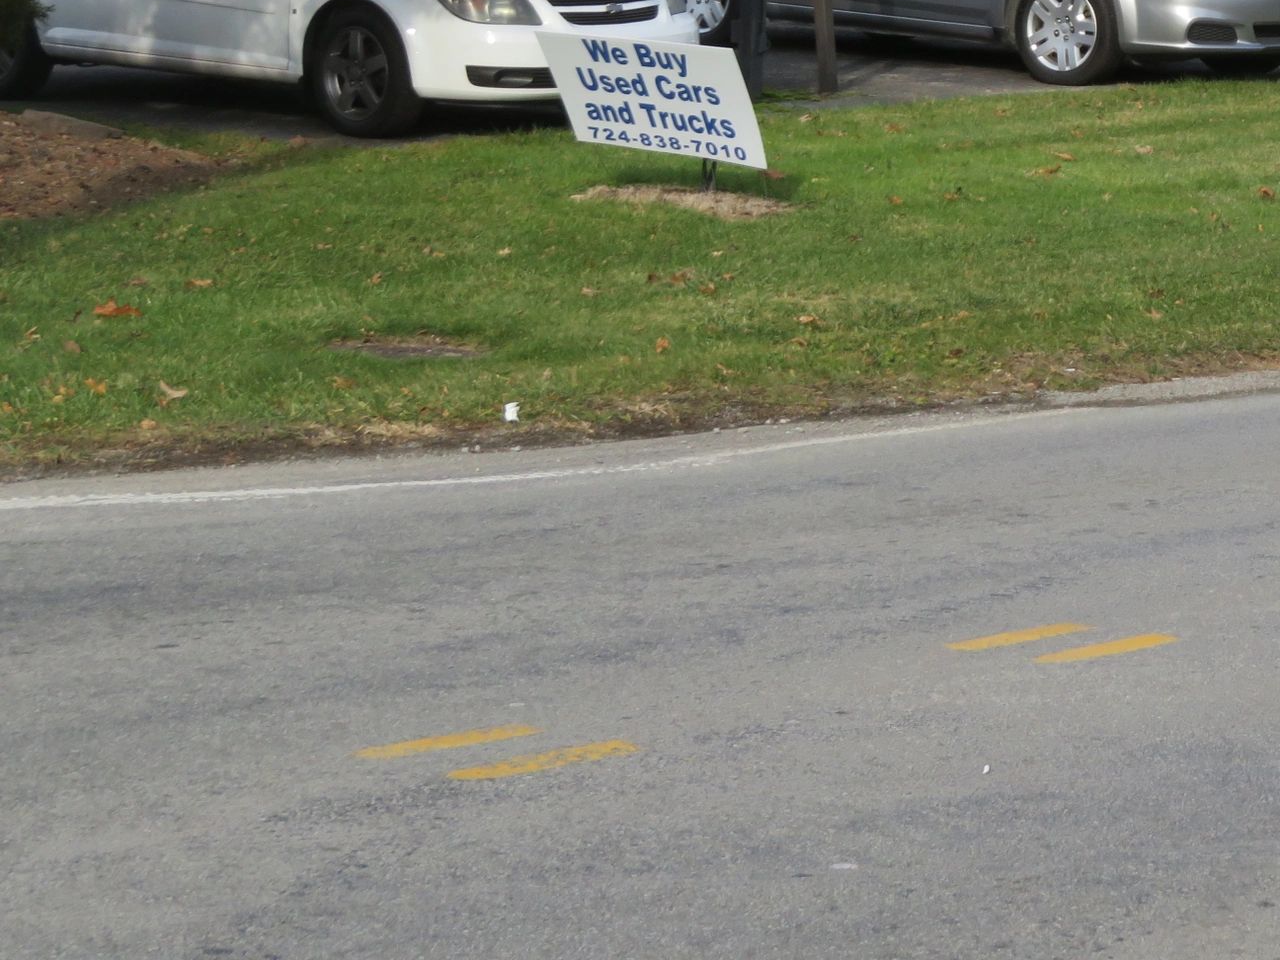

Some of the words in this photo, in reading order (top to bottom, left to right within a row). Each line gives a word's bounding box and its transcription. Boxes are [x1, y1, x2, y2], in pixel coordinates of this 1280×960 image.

[581, 38, 628, 65] We
[633, 43, 688, 77] Buy
[576, 67, 649, 97] Used
[655, 75, 721, 105] Cars
[585, 101, 635, 125] and
[639, 103, 737, 139] Trucks
[587, 126, 747, 161] 724-838-7010
